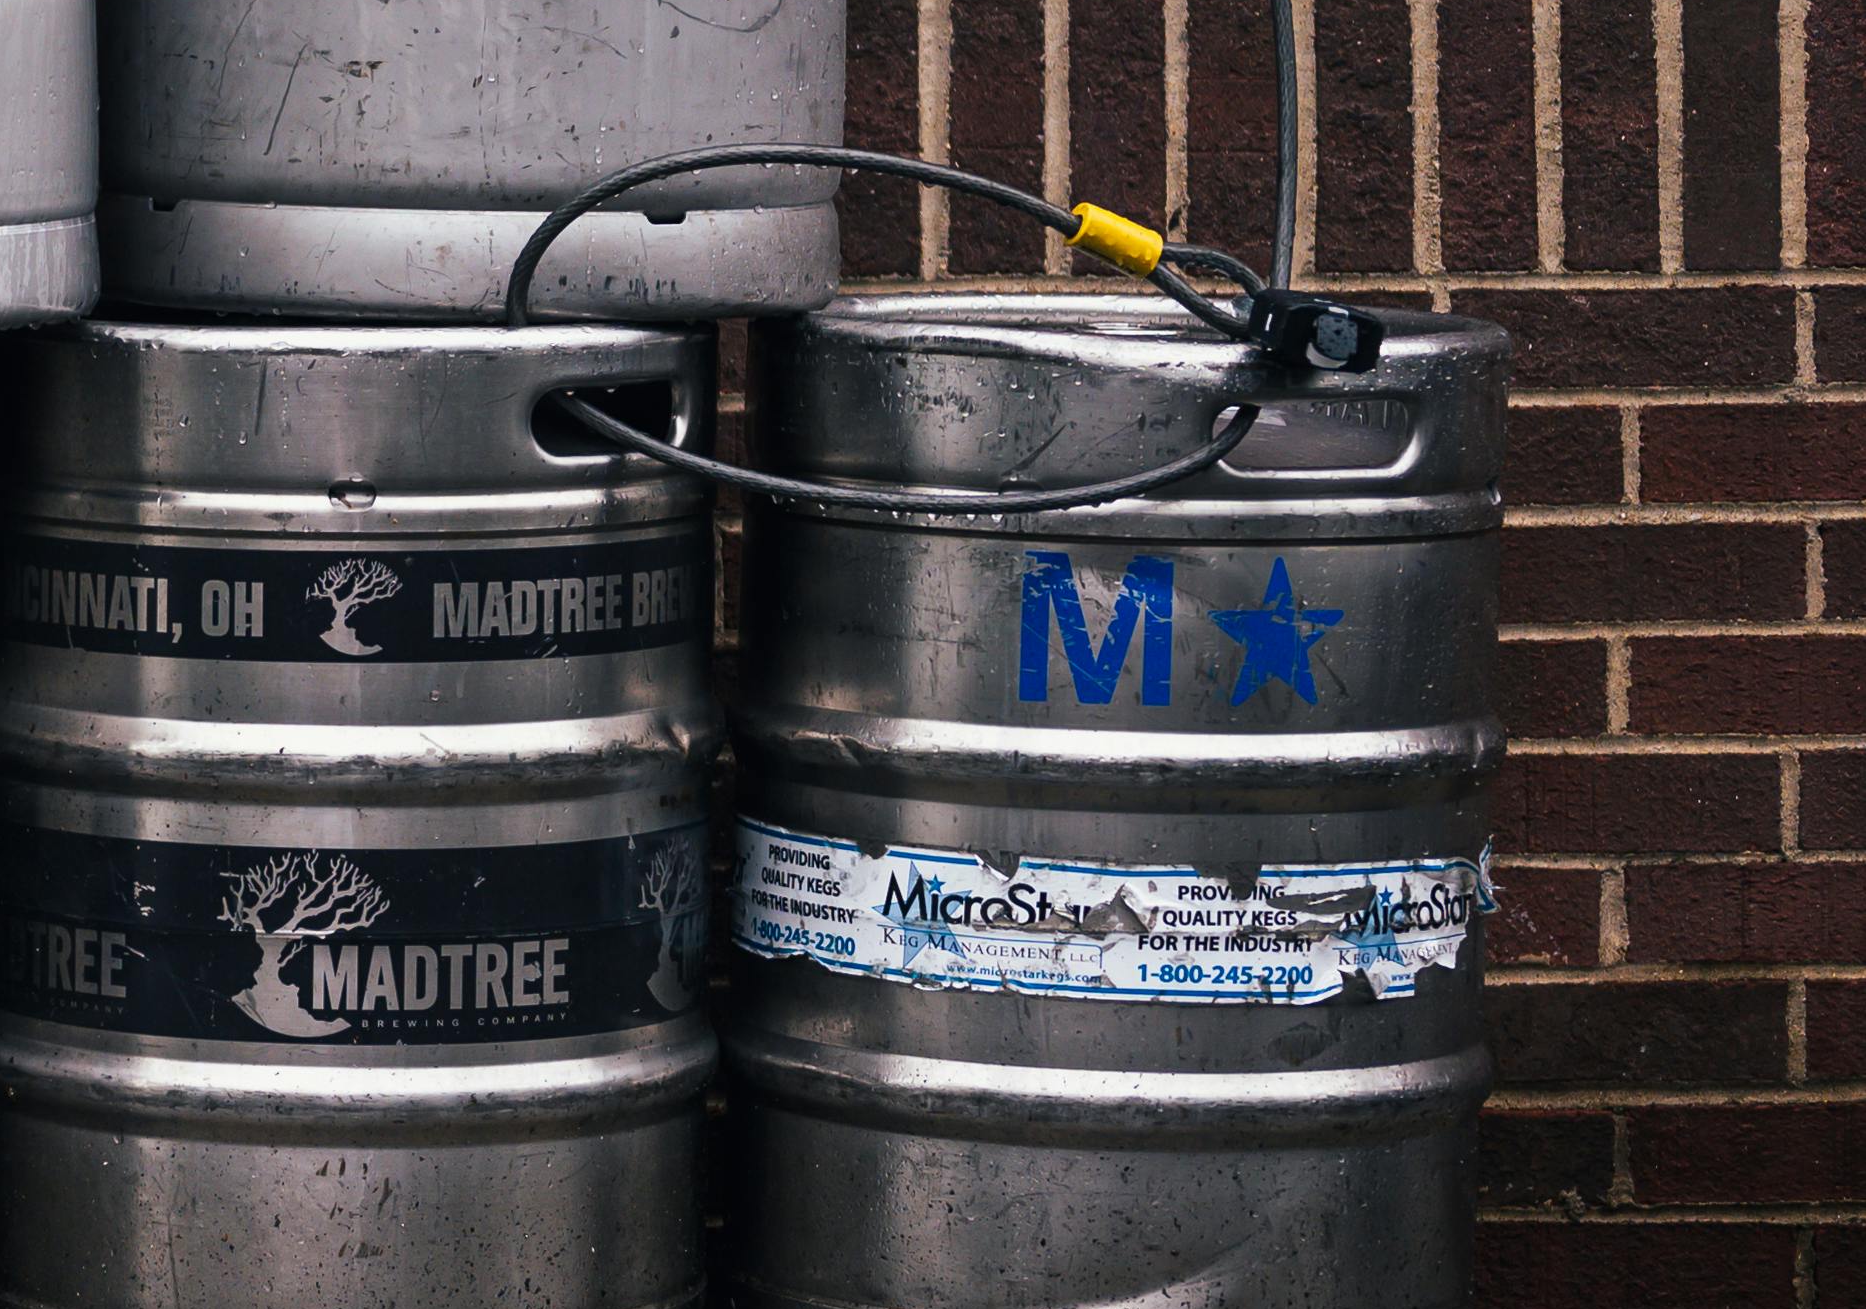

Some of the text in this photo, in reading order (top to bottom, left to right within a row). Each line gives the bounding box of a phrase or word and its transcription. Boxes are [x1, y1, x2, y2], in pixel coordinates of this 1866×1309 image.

[200, 578, 265, 638] OH
[433, 574, 623, 638] MADTREE
[1017, 551, 1176, 706] M
[768, 843, 831, 871] PROVIDING
[761, 866, 805, 891] QUALITY
[806, 878, 842, 897] KEGS
[751, 887, 856, 925] FOR THE INDUSTRY
[1162, 909, 1298, 927] QUALITY KEGS
[751, 917, 856, 957] 1-800-245-2200
[883, 928, 919, 948] KEG
[1138, 935, 1314, 953] FOR THE INDUSTRY
[14, 918, 127, 998] TREE
[1338, 949, 1371, 966] KEG
[312, 938, 570, 1011] MADTREE
[946, 962, 1103, 984] www.microstarkegs.com
[1137, 963, 1314, 985] 1-800-245-2200
[361, 1012, 567, 1029] BREWING COMPANY
